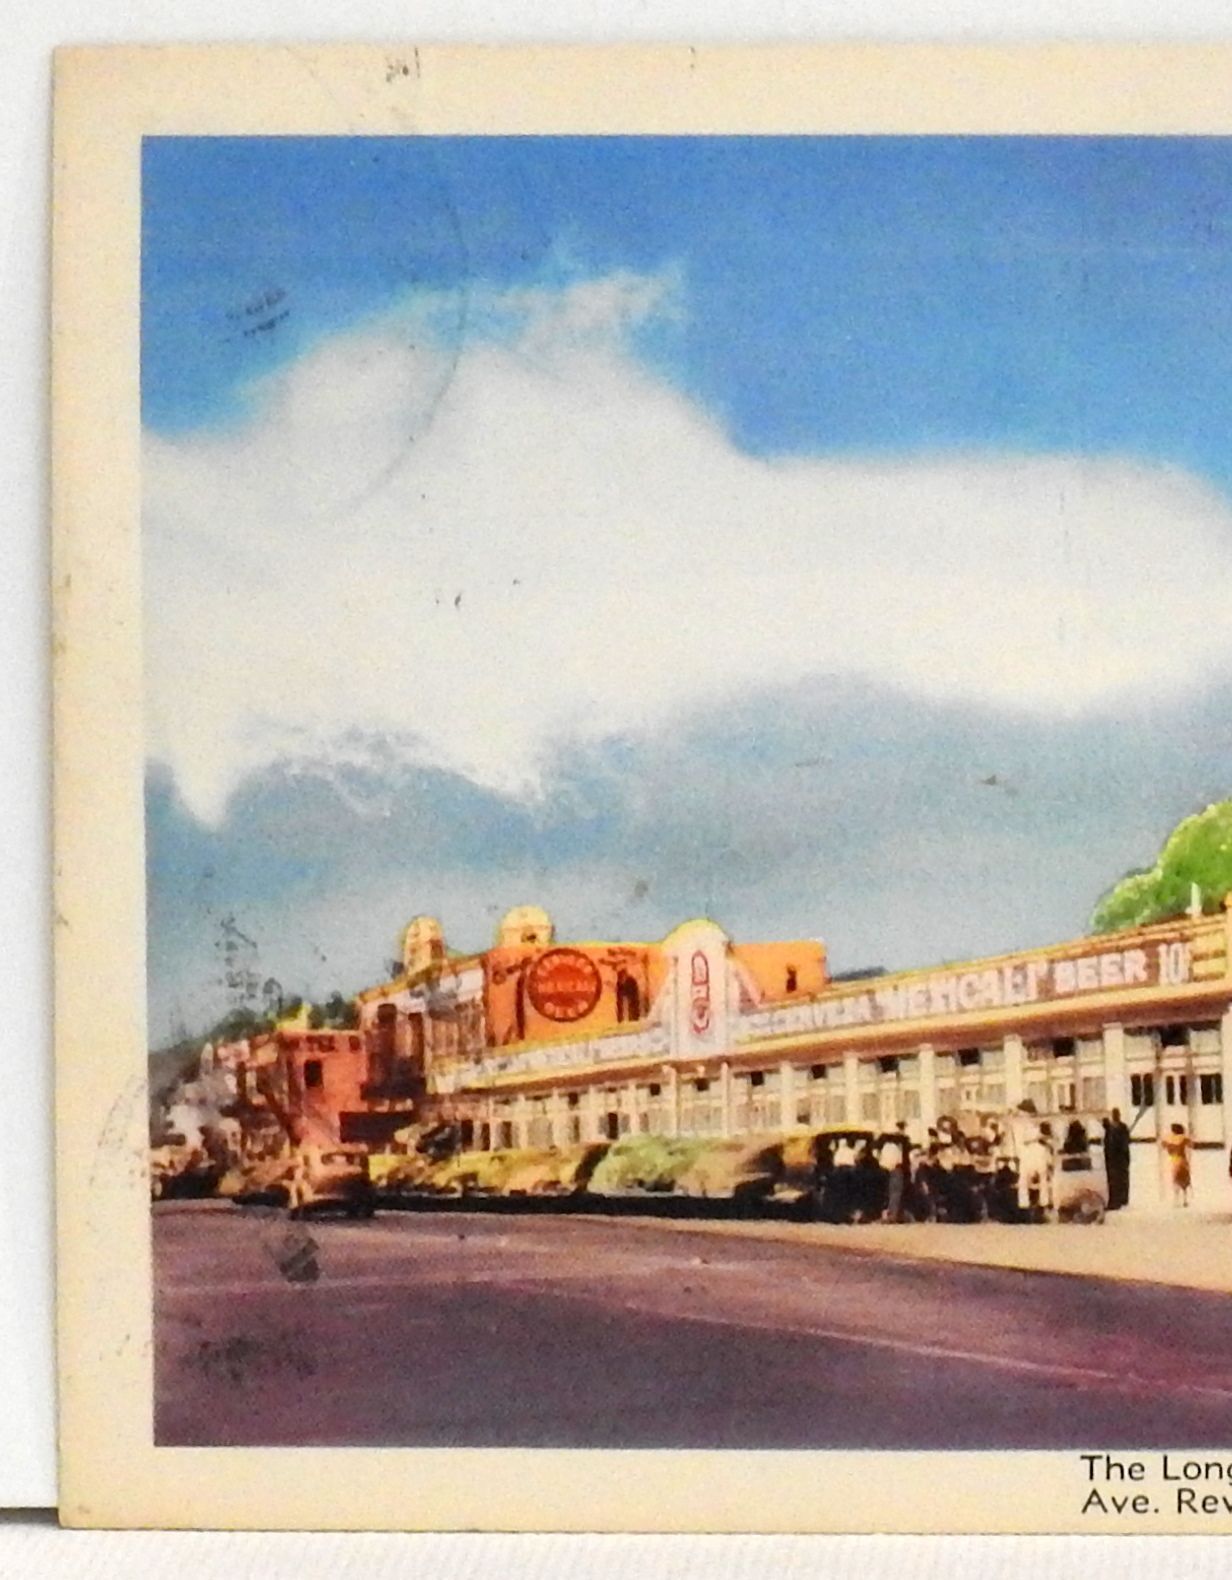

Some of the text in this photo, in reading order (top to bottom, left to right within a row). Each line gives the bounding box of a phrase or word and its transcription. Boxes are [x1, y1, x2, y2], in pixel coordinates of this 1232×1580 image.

[1053, 948, 1149, 994] BEER
[1081, 1455, 1144, 1481] The
[1081, 1488, 1159, 1514] Ave.
